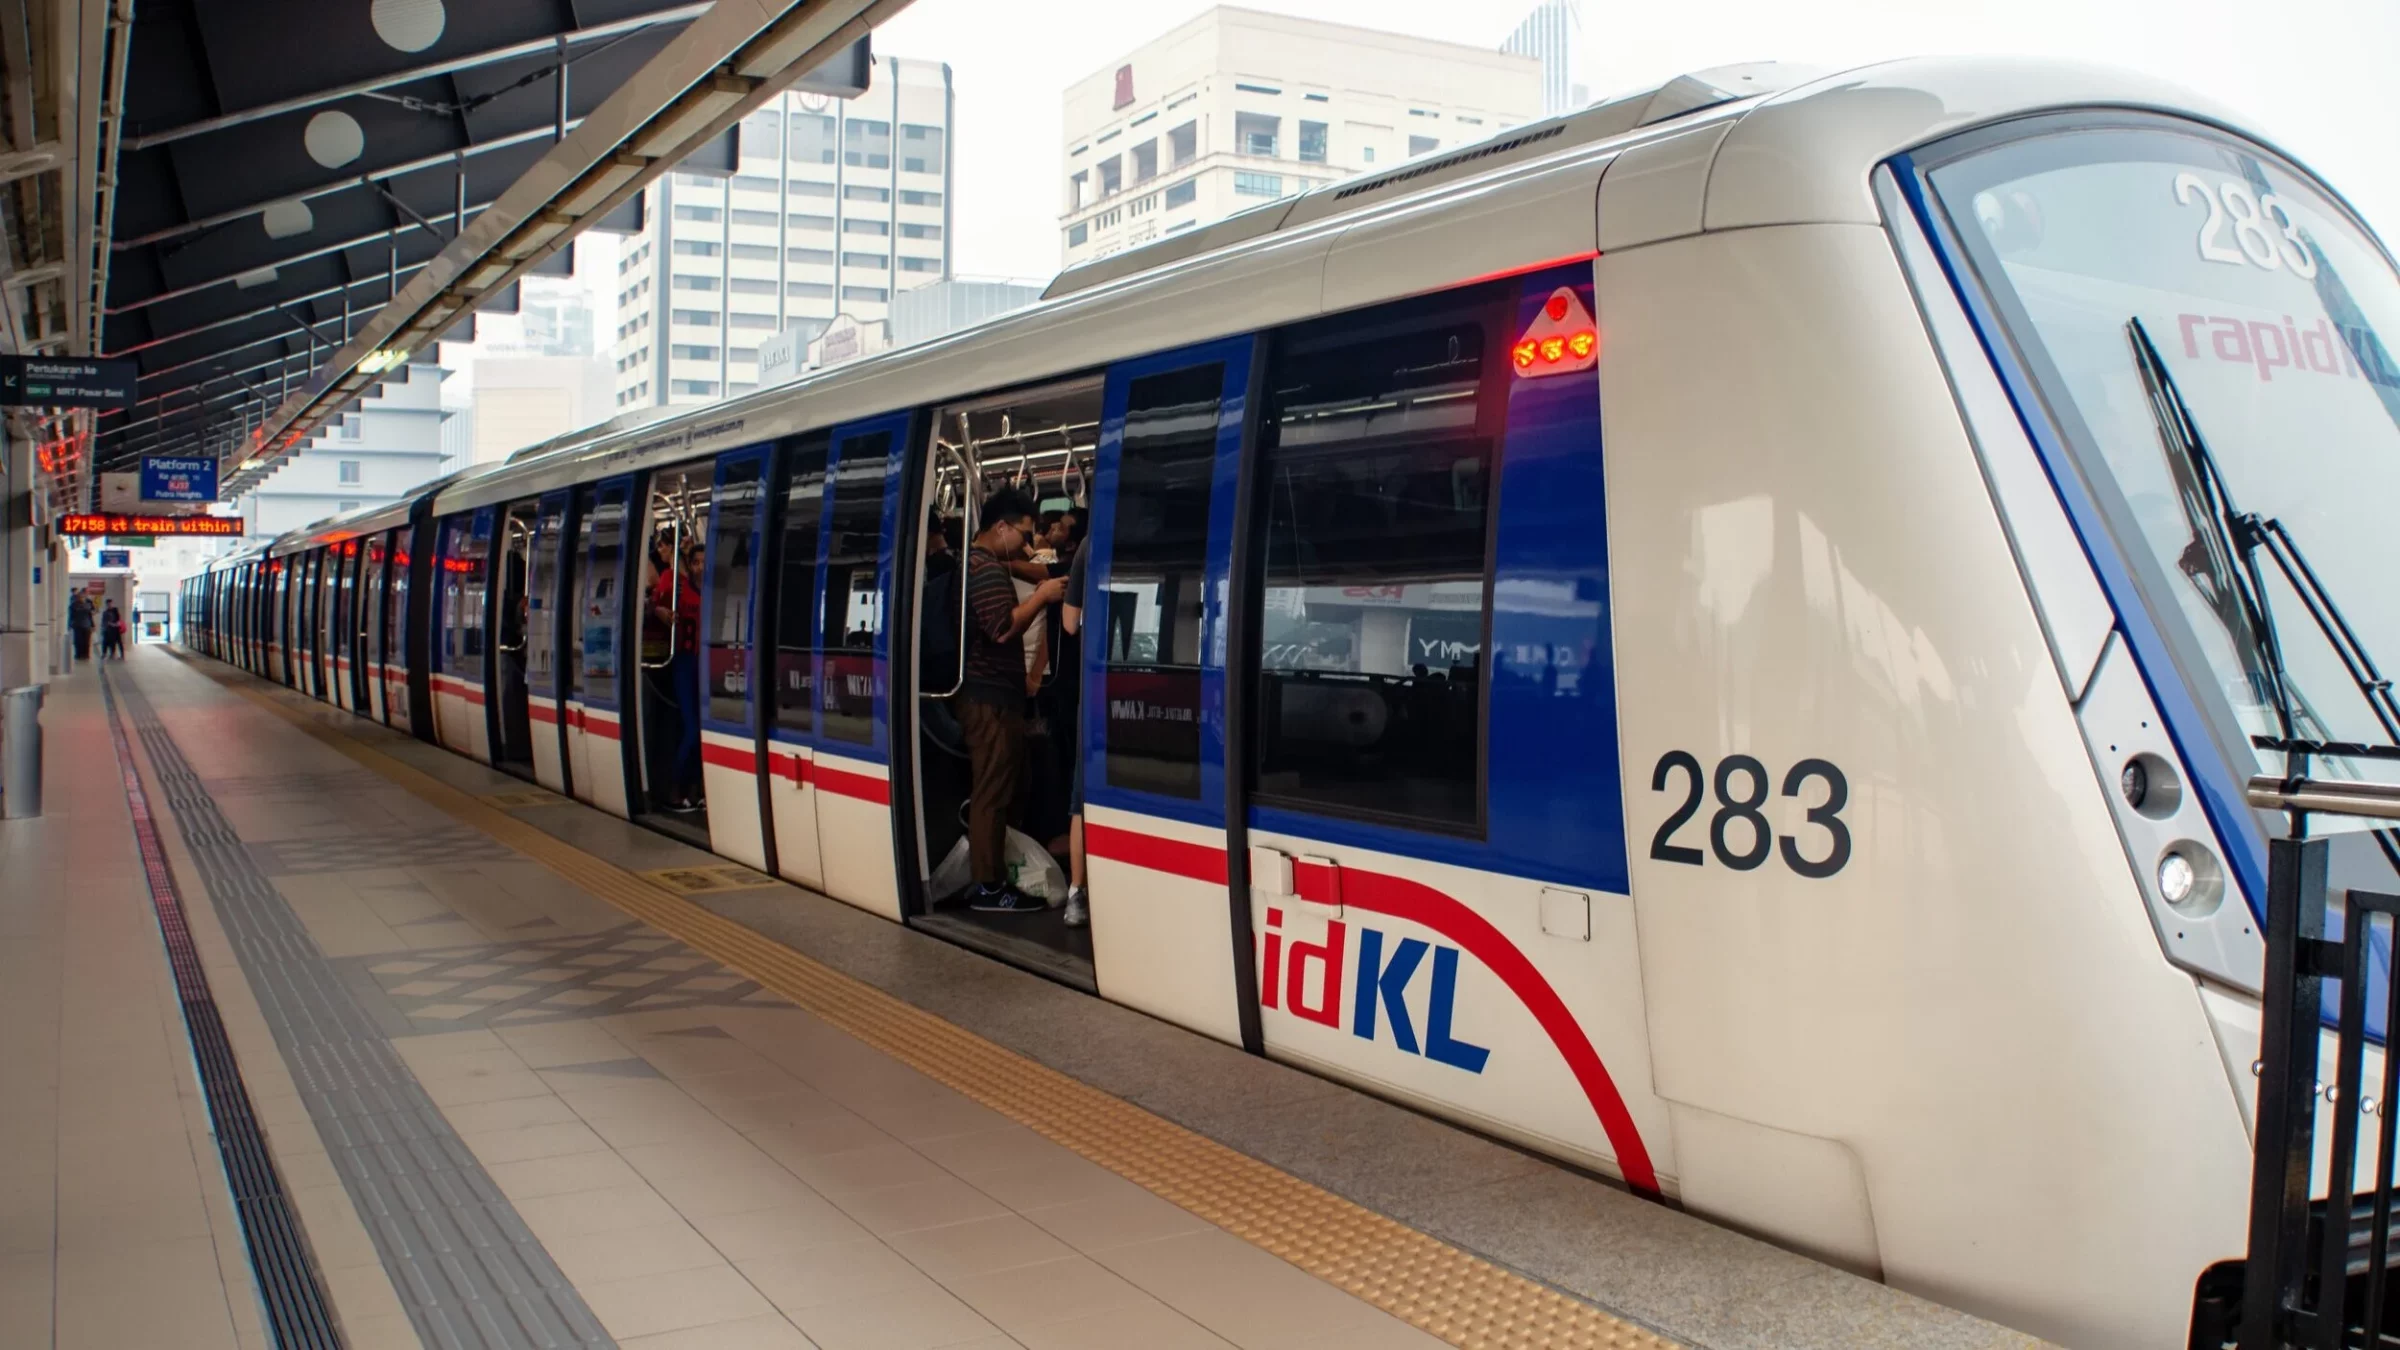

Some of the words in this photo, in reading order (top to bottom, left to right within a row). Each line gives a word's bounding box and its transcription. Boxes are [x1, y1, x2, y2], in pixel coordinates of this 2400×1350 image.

[2172, 171, 2318, 280] 283
[26, 363, 82, 374] Pertukaran
[84, 365, 97, 375] ke
[78, 388, 102, 397] Pasar
[104, 388, 124, 397] Seni
[149, 458, 200, 470] Platform
[203, 460, 211, 471] 2
[155, 490, 175, 498] Putra
[176, 491, 203, 499] Heights
[64, 519, 106, 532] 17:58
[133, 520, 175, 532] train
[181, 520, 230, 532] within
[1649, 749, 1852, 879] 283
[1252, 906, 1491, 1075] idKL
